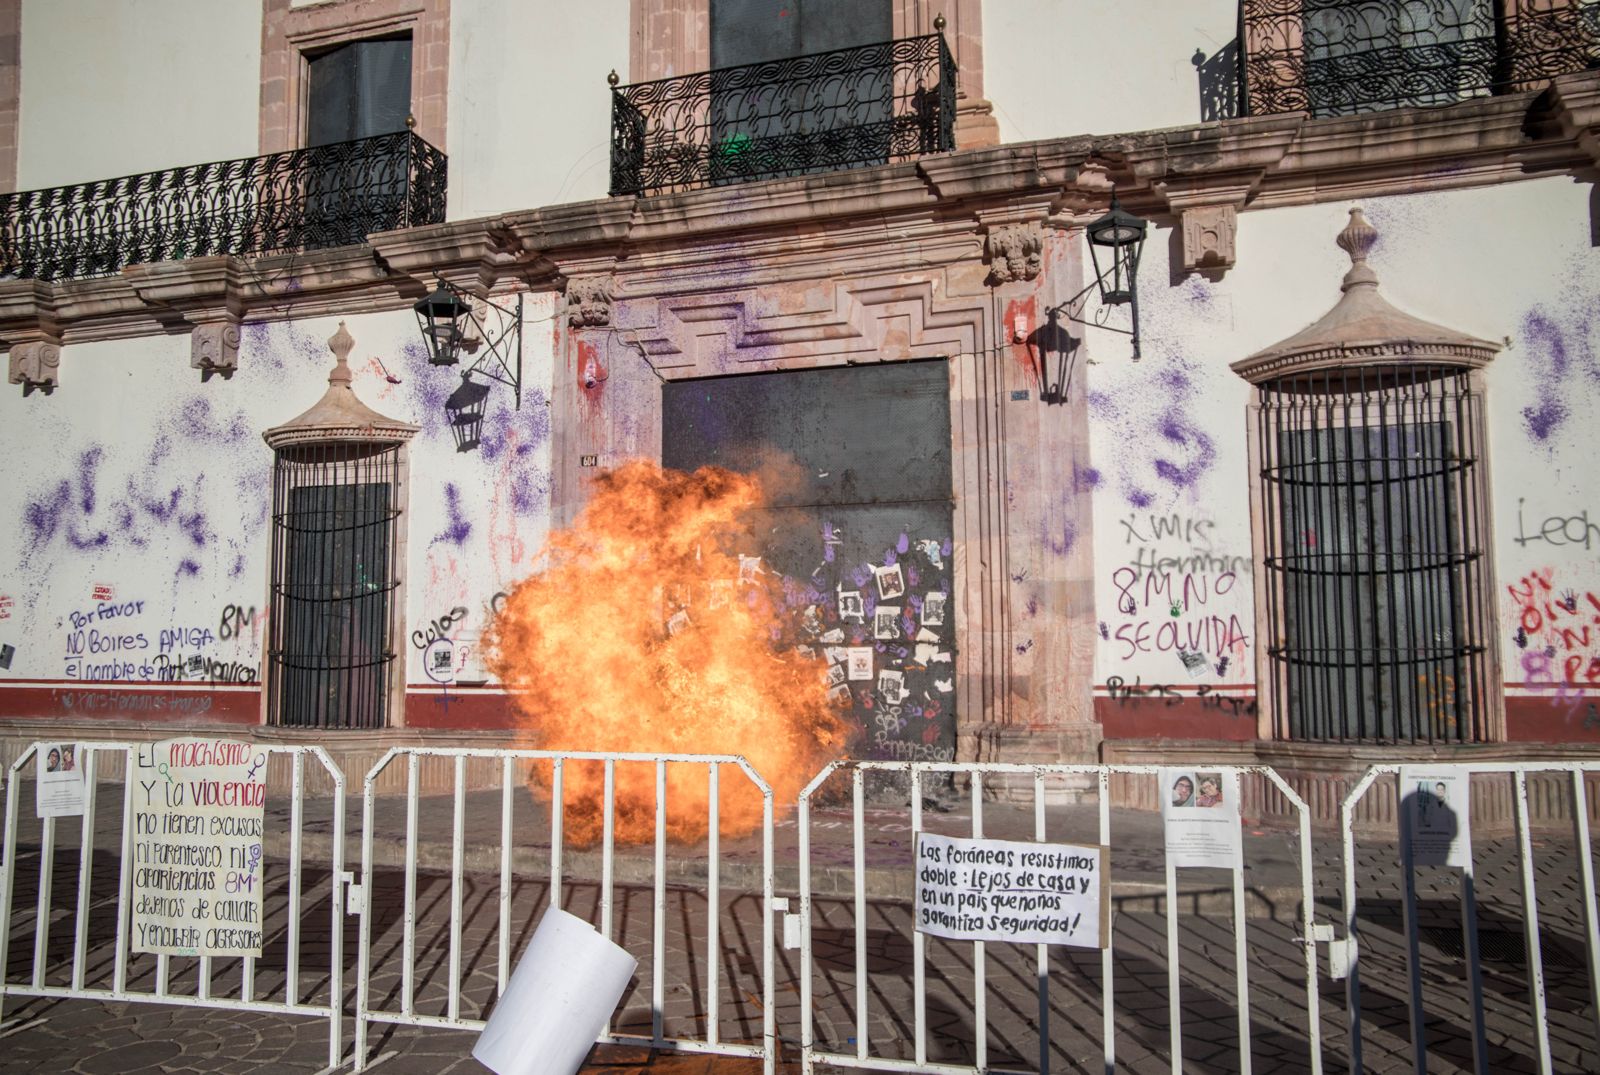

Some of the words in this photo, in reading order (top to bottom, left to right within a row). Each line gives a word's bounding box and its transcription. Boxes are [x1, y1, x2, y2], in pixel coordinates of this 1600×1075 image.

[69, 611, 97, 629] Por
[97, 601, 145, 621] favor
[220, 603, 256, 641] 8M
[160, 627, 215, 652] AMIGA
[86, 658, 136, 683] nombre
[138, 742, 157, 768] El
[140, 780, 156, 806] Y
[165, 781, 184, 807] la
[190, 778, 266, 808] violencia
[136, 812, 157, 835] no
[162, 811, 204, 835] tienen
[136, 840, 150, 864] ni
[230, 844, 246, 869] ni
[920, 841, 941, 863] Las
[946, 844, 1014, 867] foráneas
[1021, 851, 1095, 872] resistimos
[1016, 871, 1034, 888] de
[1038, 873, 1076, 892] casa
[1080, 876, 1091, 895] y
[136, 894, 185, 918] dejemos
[192, 898, 210, 920] de
[921, 888, 937, 906] en
[940, 892, 955, 906] un
[991, 894, 1018, 913] que
